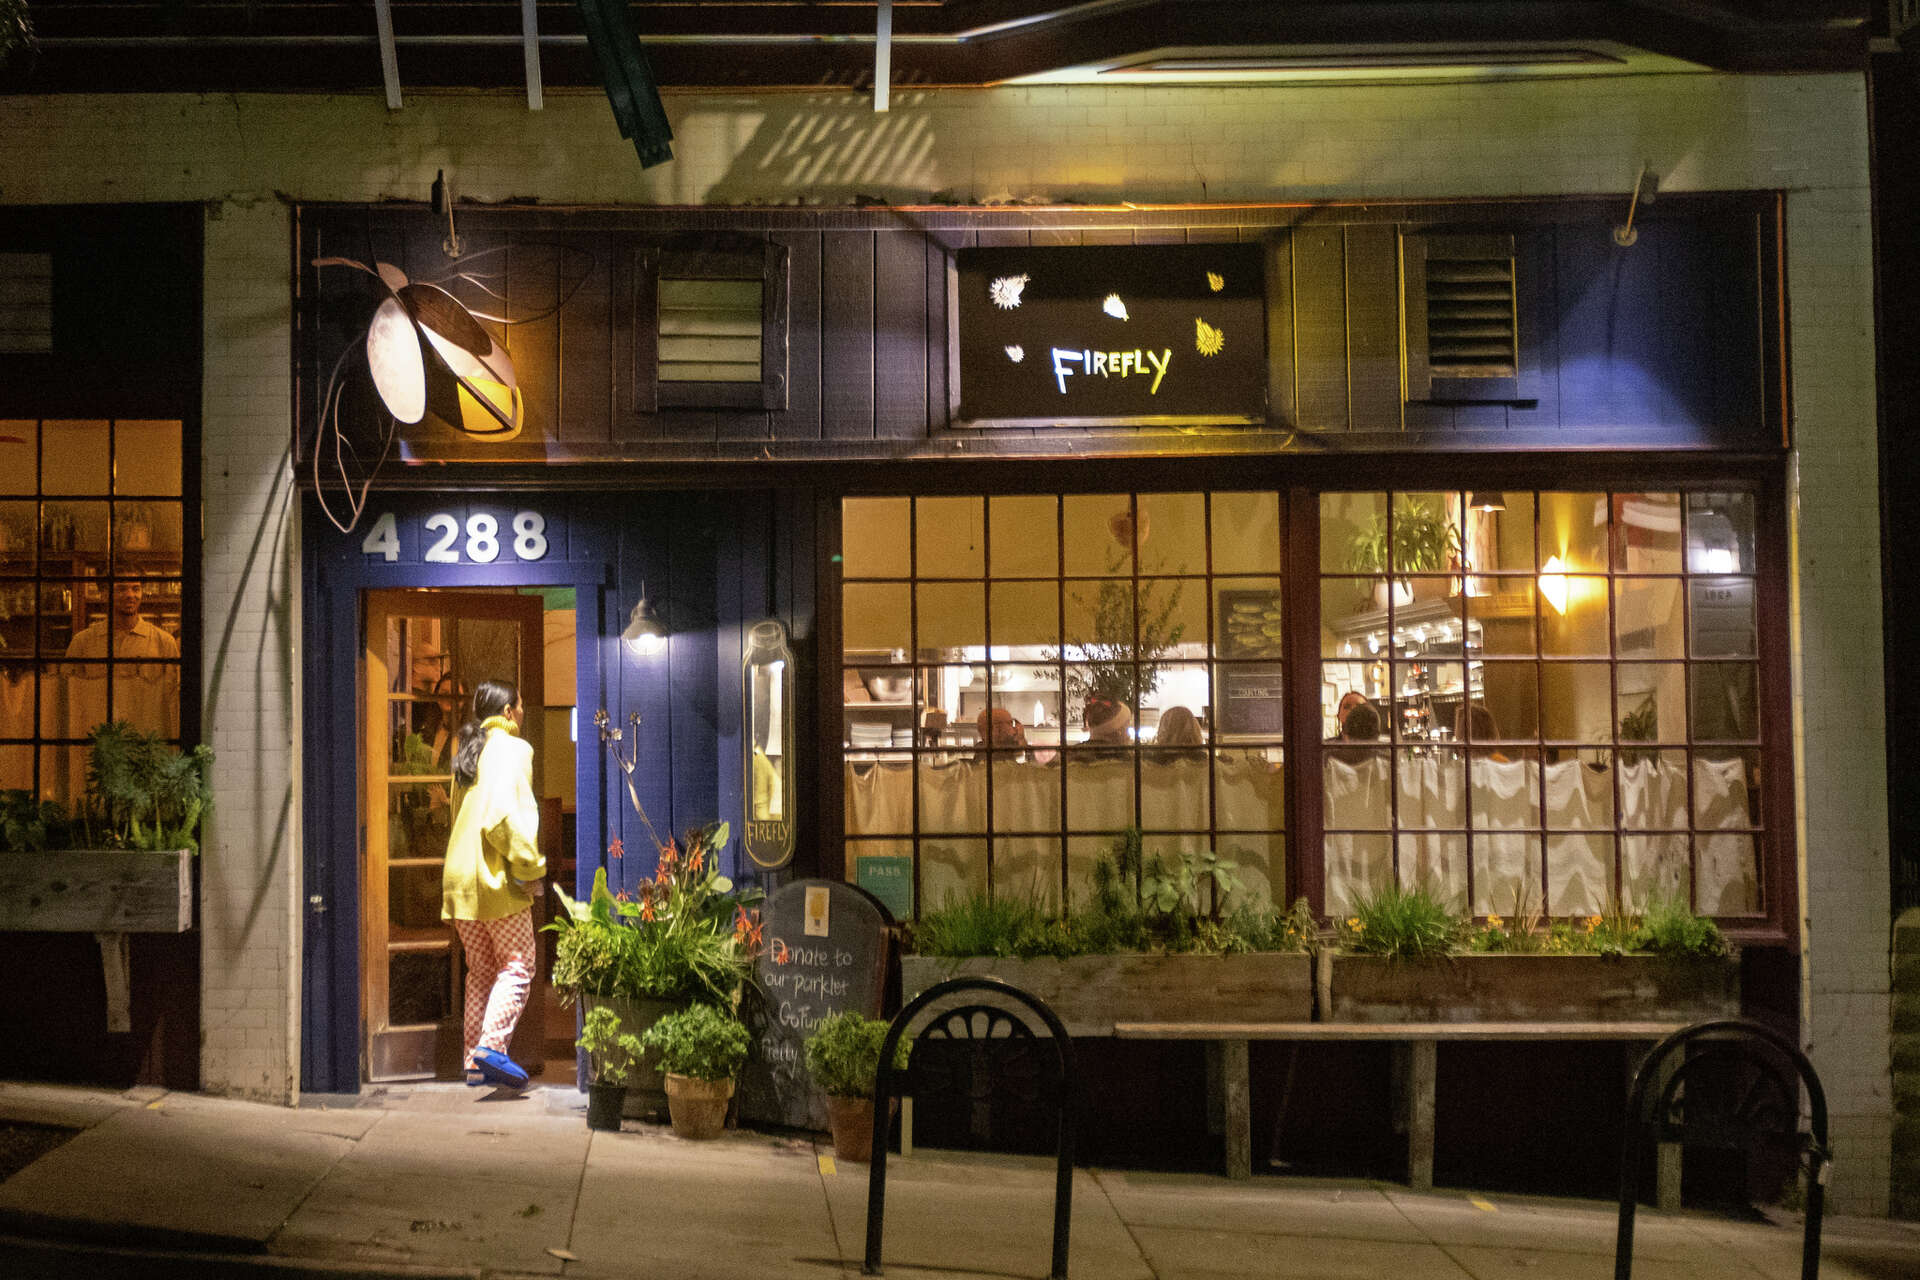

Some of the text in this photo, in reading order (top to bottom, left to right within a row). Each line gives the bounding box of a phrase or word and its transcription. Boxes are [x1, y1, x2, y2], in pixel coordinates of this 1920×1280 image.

[1052, 347, 1172, 395] FIREFLY
[362, 511, 548, 563] 4288
[747, 821, 790, 847] FIREFLY
[835, 948, 853, 965] to
[764, 973, 787, 988] our
